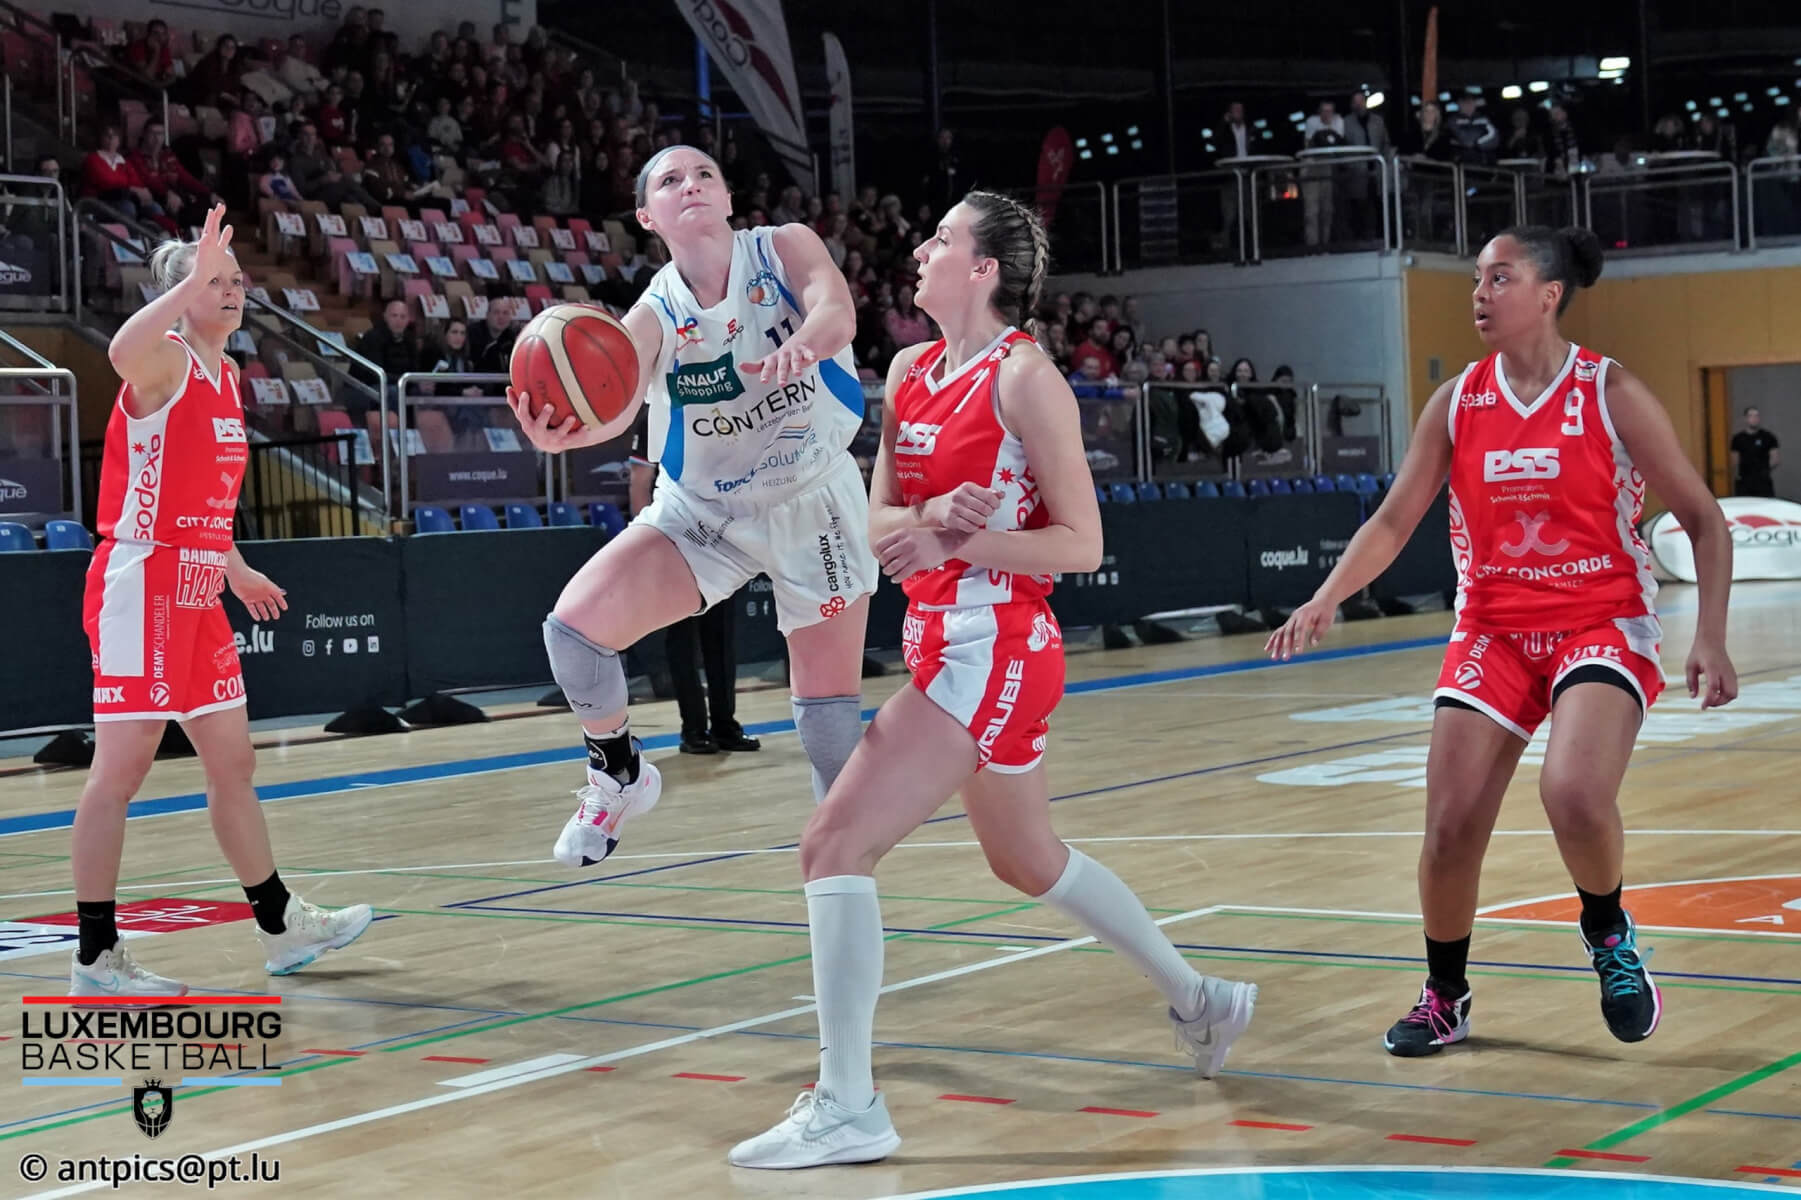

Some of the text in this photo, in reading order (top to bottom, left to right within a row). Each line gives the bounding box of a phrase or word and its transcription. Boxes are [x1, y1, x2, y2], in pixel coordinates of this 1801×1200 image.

[676, 366, 728, 389] KNAUF
[678, 380, 734, 398] shopping
[692, 375, 816, 437] CONTERN
[1561, 387, 1585, 436] 9
[1483, 447, 1561, 483] PSS
[134, 434, 161, 540] sodexo
[176, 516, 208, 528] CITY
[819, 533, 840, 592] cargolux
[1260, 545, 1309, 570] coque.lu
[1506, 553, 1614, 582] CONCORDE
[305, 613, 375, 629] Follow us on
